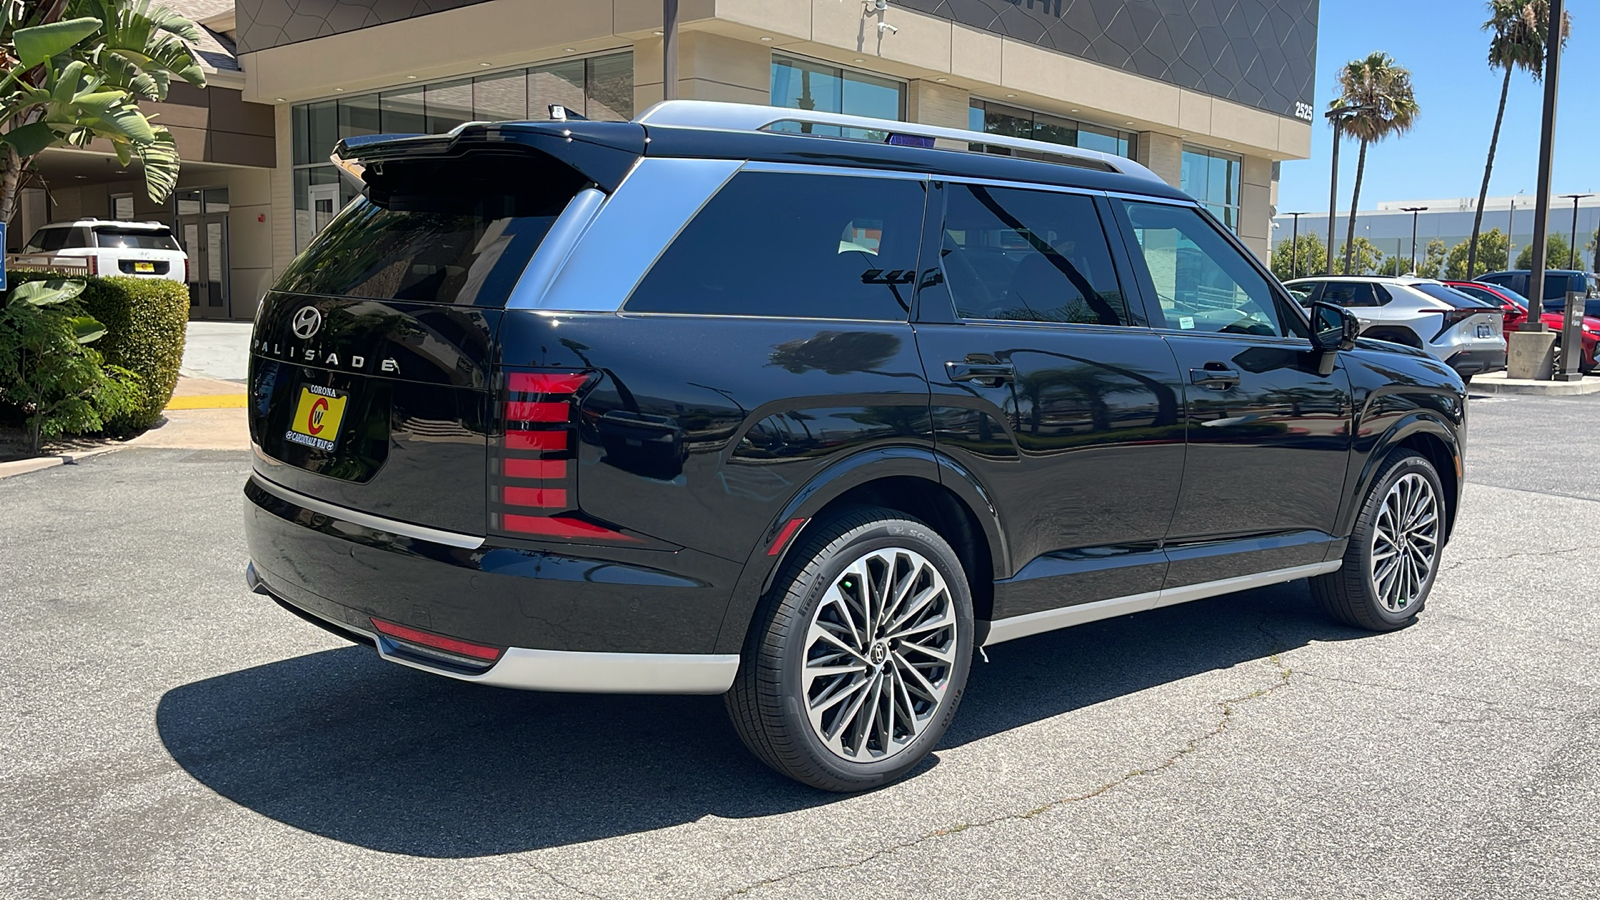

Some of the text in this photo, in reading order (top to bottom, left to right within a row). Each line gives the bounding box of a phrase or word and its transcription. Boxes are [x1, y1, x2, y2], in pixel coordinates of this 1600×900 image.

[1295, 101, 1313, 121] 2525
[254, 339, 395, 372] PALISADE
[310, 384, 336, 397] CORONA
